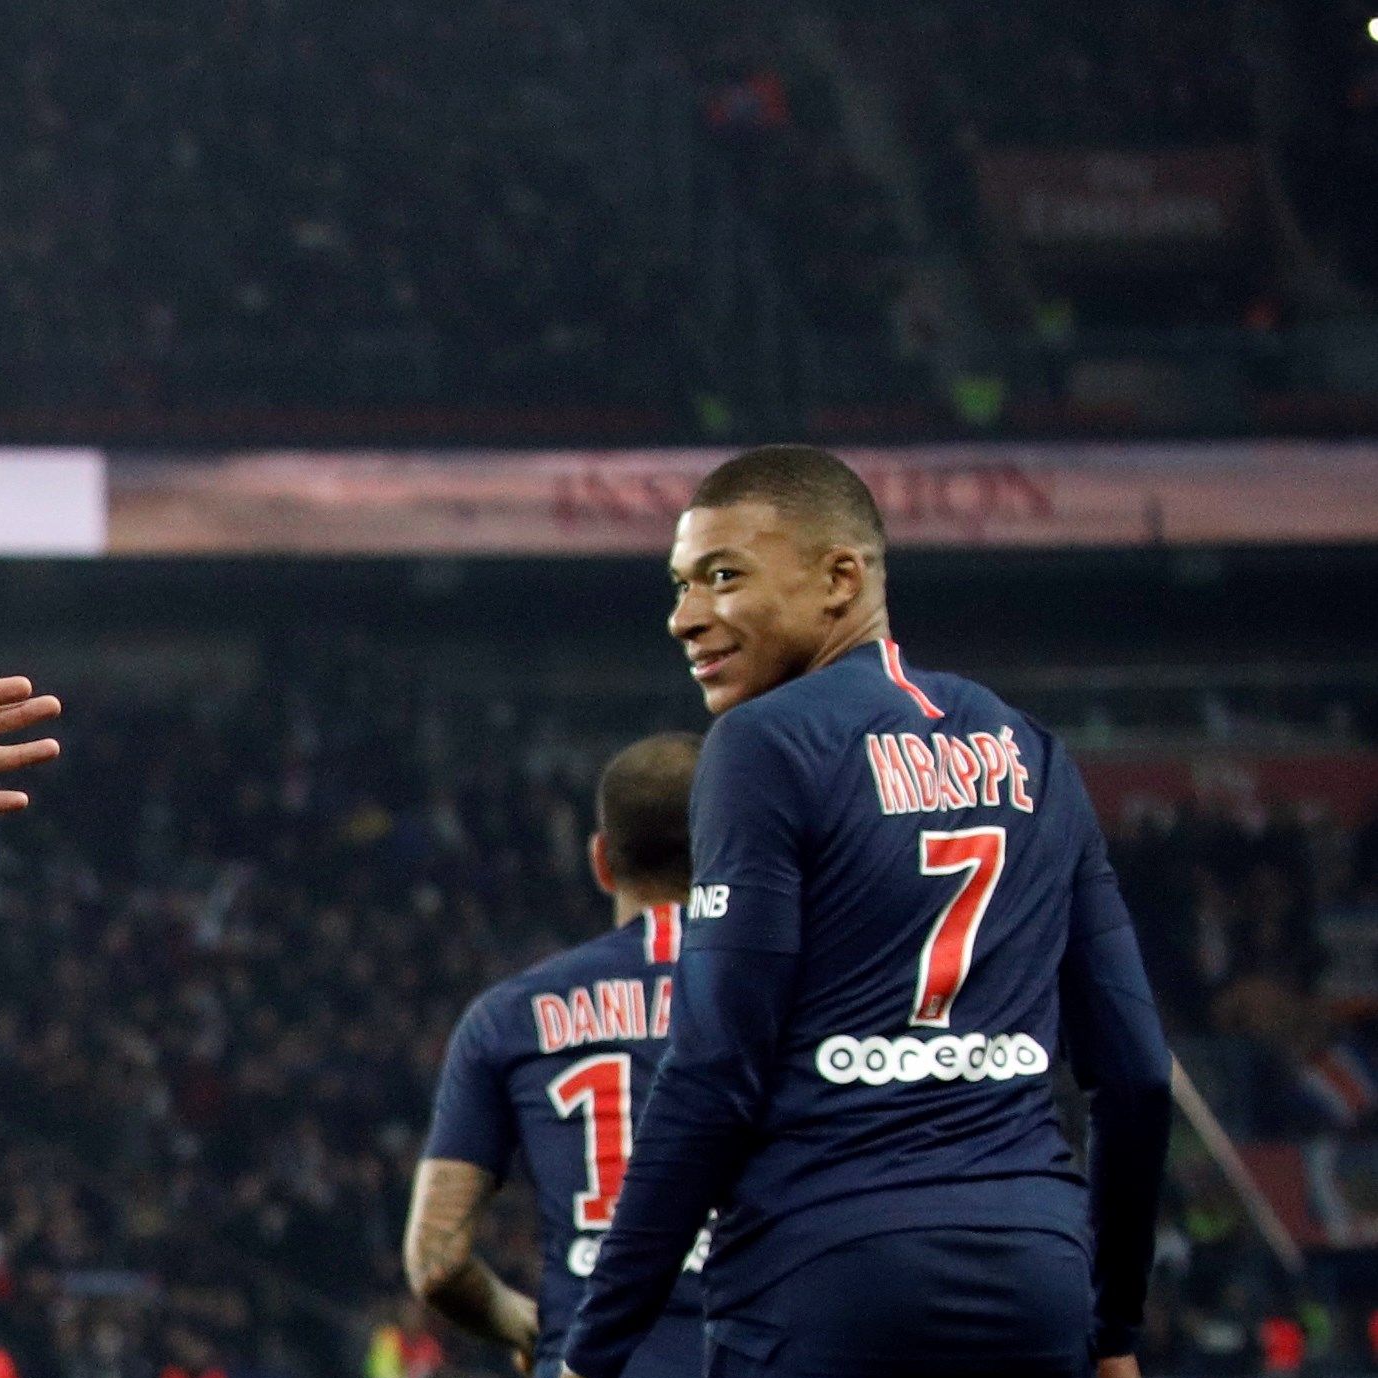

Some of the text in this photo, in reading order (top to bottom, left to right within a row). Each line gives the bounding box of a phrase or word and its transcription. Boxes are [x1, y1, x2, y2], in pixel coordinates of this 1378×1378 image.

[866, 725, 1034, 816] MBAPPÉ
[687, 884, 731, 920] NB
[909, 826, 1007, 1028] 7
[531, 978, 648, 1055] DANI
[814, 1032, 1050, 1086] ooredoo
[546, 1052, 634, 1231] 1
